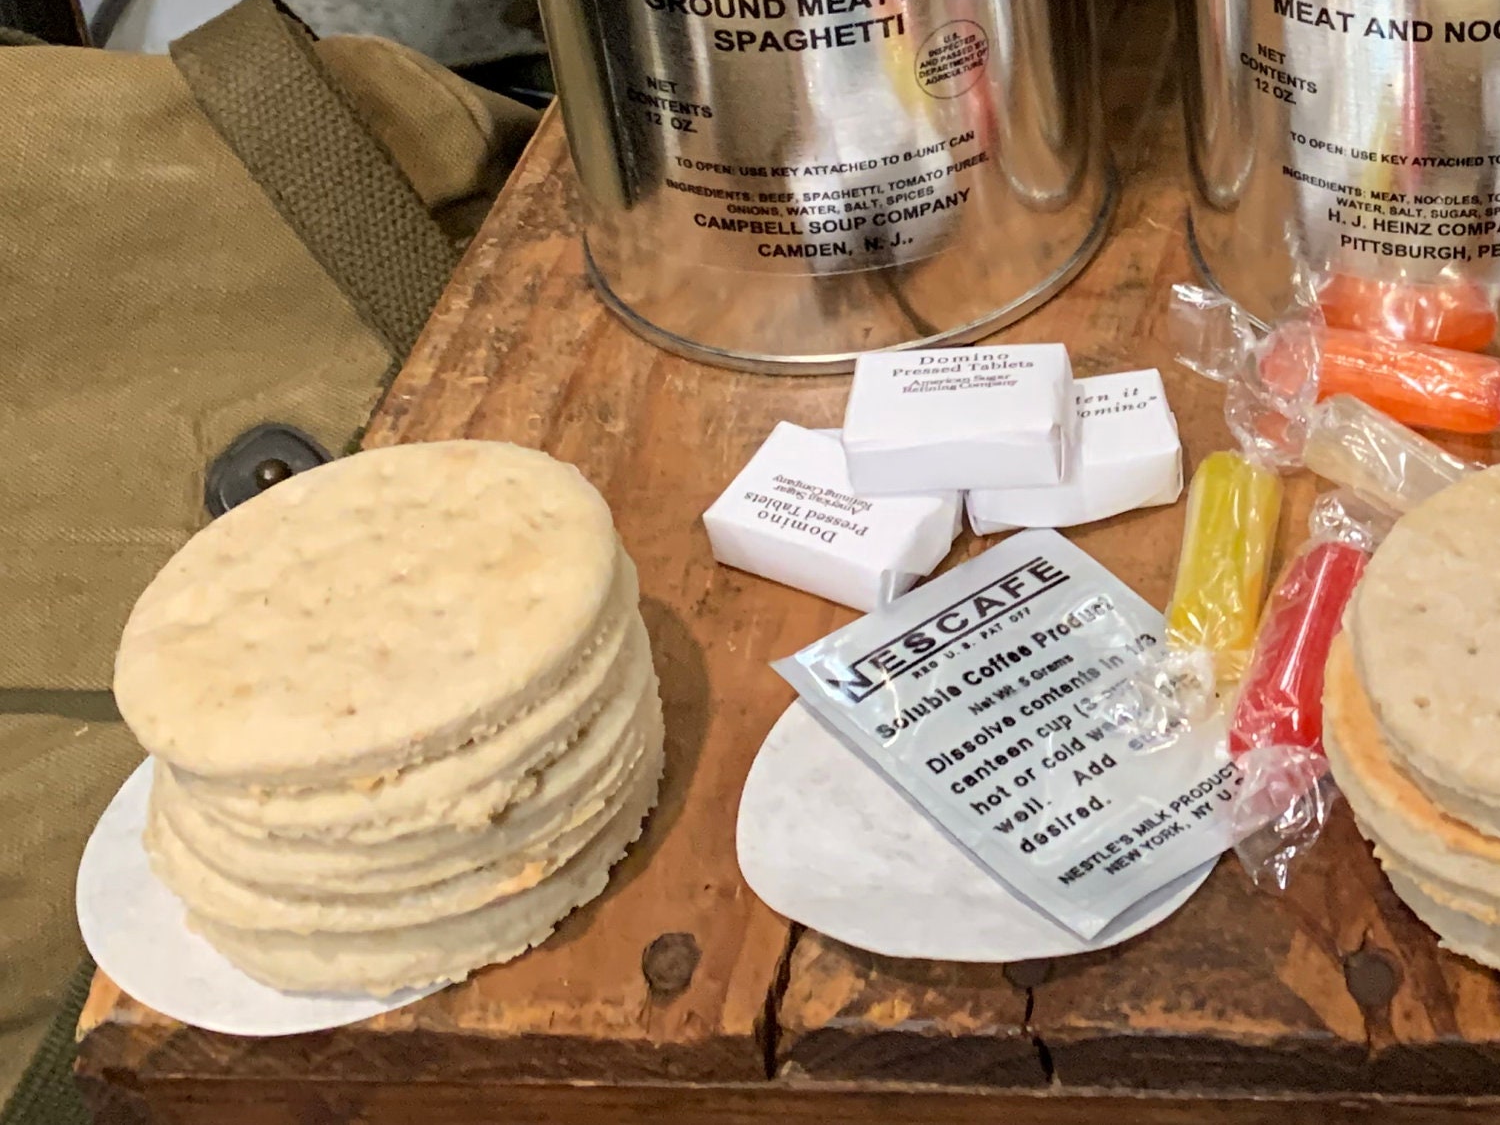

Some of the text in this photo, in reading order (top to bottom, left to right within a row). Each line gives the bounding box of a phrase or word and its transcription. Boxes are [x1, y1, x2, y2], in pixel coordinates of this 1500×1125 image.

[714, 13, 905, 52] SPAGHETTI
[1364, 21, 1433, 43] AND
[1257, 44, 1286, 64] NET
[1240, 52, 1317, 94] CONTENTS
[1256, 77, 1271, 94] 12
[1290, 131, 1306, 146] TO
[1351, 148, 1378, 163] USE
[1381, 153, 1409, 166] KEY
[1412, 154, 1484, 167] ATTACHED
[888, 170, 943, 190] TOMATO
[694, 188, 972, 235] CAMPBELL SOUP COMPANY
[1328, 208, 1346, 224] H.
[1352, 214, 1366, 228] J.
[1373, 216, 1432, 236] HEINZ
[758, 241, 852, 258] CAMDEN,
[1340, 235, 1472, 261] PITTSBURGH,
[892, 359, 1035, 377] Pressed Tablets
[919, 349, 1010, 365] Domino
[973, 372, 1012, 384] Sugar
[744, 490, 870, 536] Pressed Tablets
[757, 509, 836, 544] Domino
[826, 559, 1064, 698] NESCAFE
[876, 646, 1032, 739] Soluble Coffee
[926, 715, 1016, 774] Dissolve
[951, 713, 1072, 794] canteen cup
[970, 737, 1086, 815] hot or cold
[1072, 753, 1117, 786] Add
[1058, 808, 1171, 885] NESTLE'S MILK
[1104, 821, 1191, 875] NEW YORK,
